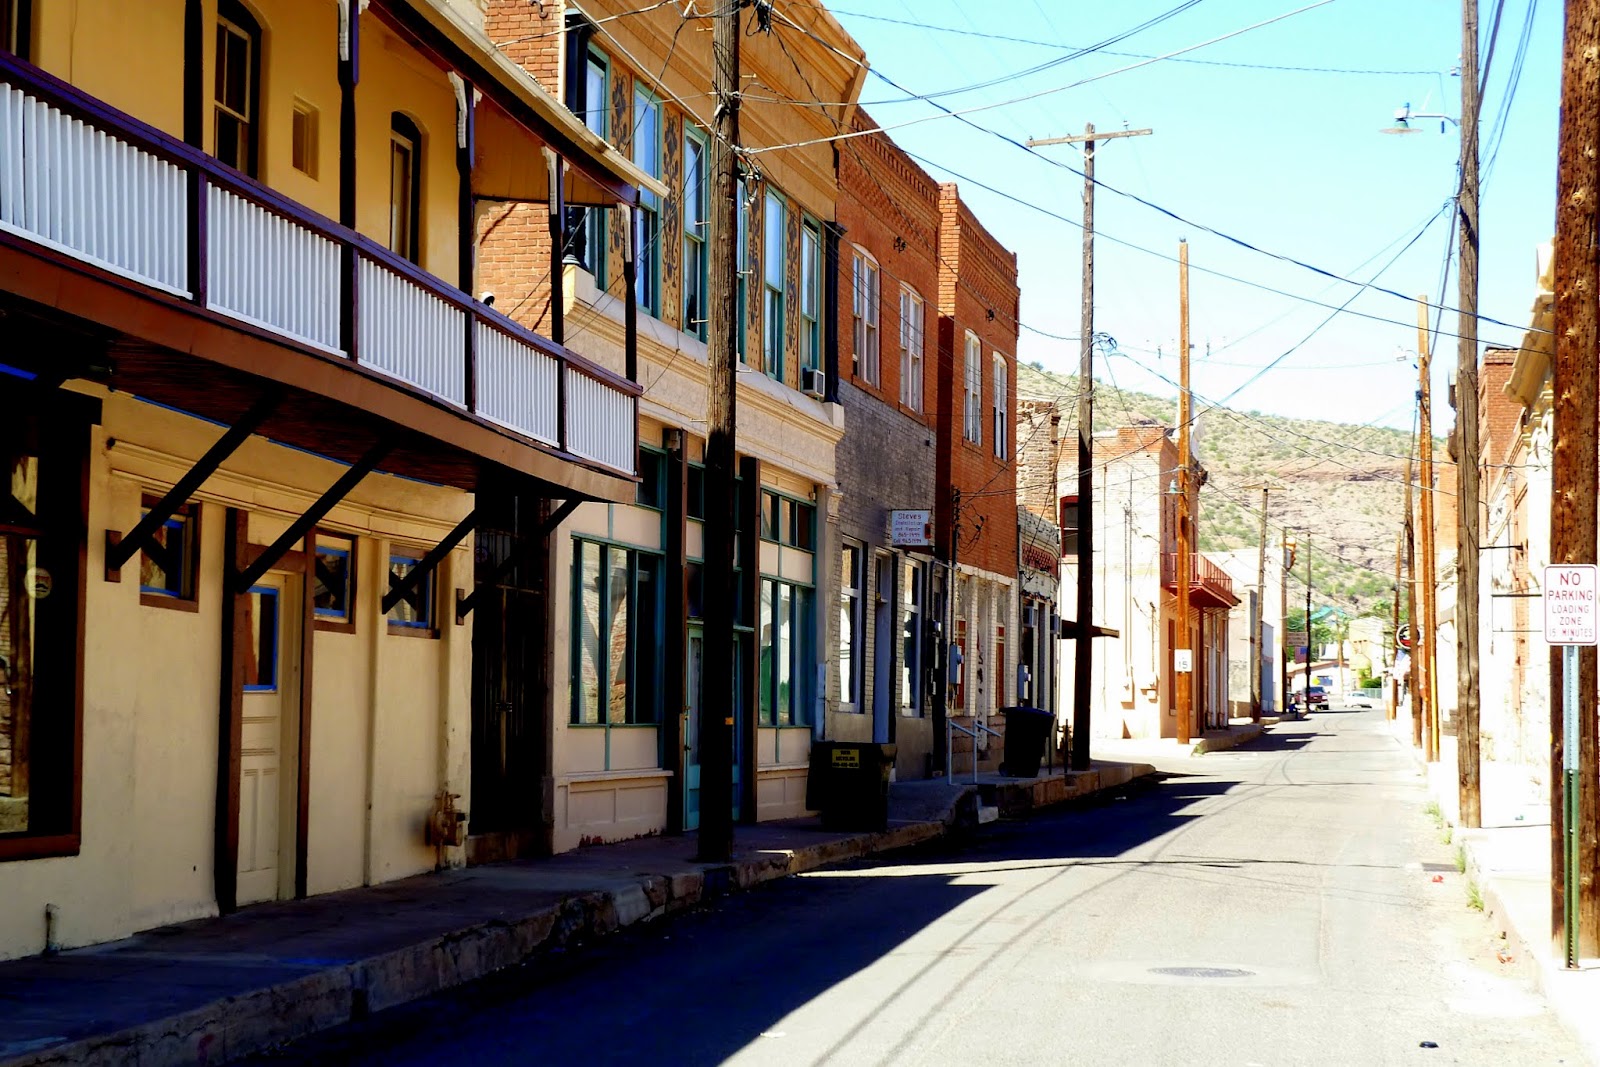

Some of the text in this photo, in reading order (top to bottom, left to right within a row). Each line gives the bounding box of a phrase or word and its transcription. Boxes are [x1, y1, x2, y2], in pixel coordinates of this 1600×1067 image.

[898, 512, 921, 520] Steves
[1560, 572, 1581, 586] NO
[1548, 590, 1593, 601] PARKING
[1552, 604, 1589, 614] LOADING
[1559, 616, 1582, 626] ZONE
[1562, 628, 1593, 637] MINUTES
[1178, 661, 1188, 670] 15
